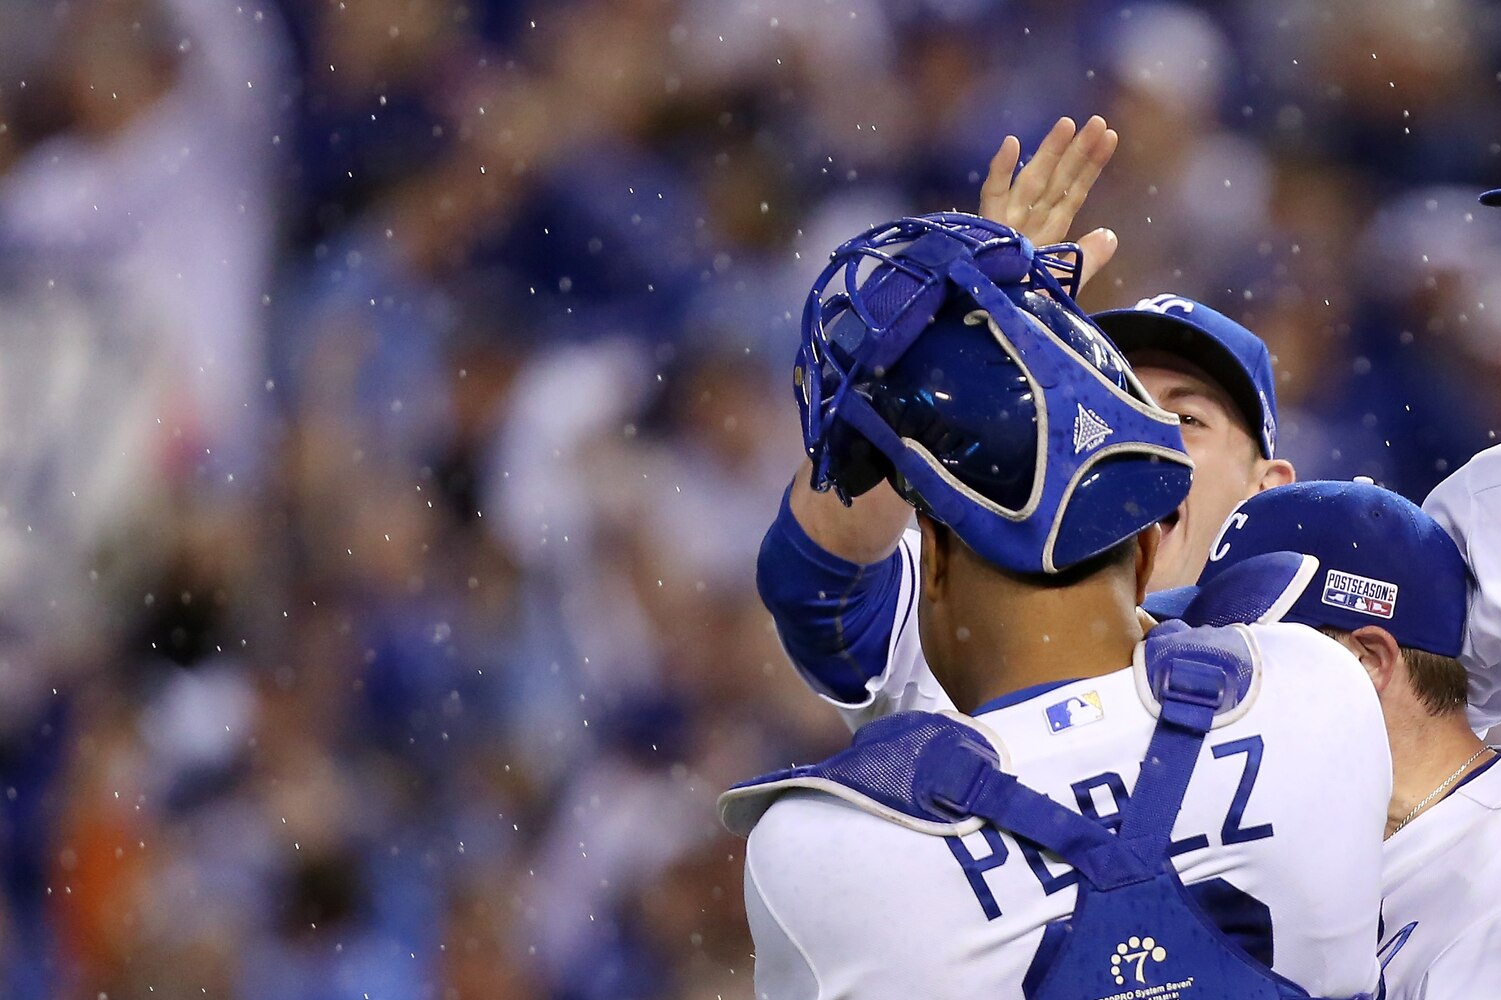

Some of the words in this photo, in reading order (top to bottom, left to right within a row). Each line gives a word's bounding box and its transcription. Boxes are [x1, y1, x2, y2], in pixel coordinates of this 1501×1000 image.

[1208, 499, 1249, 562] C
[1327, 572, 1390, 602] POSTSEASON
[1121, 950, 1149, 984] 7
[1135, 986, 1165, 999] System
